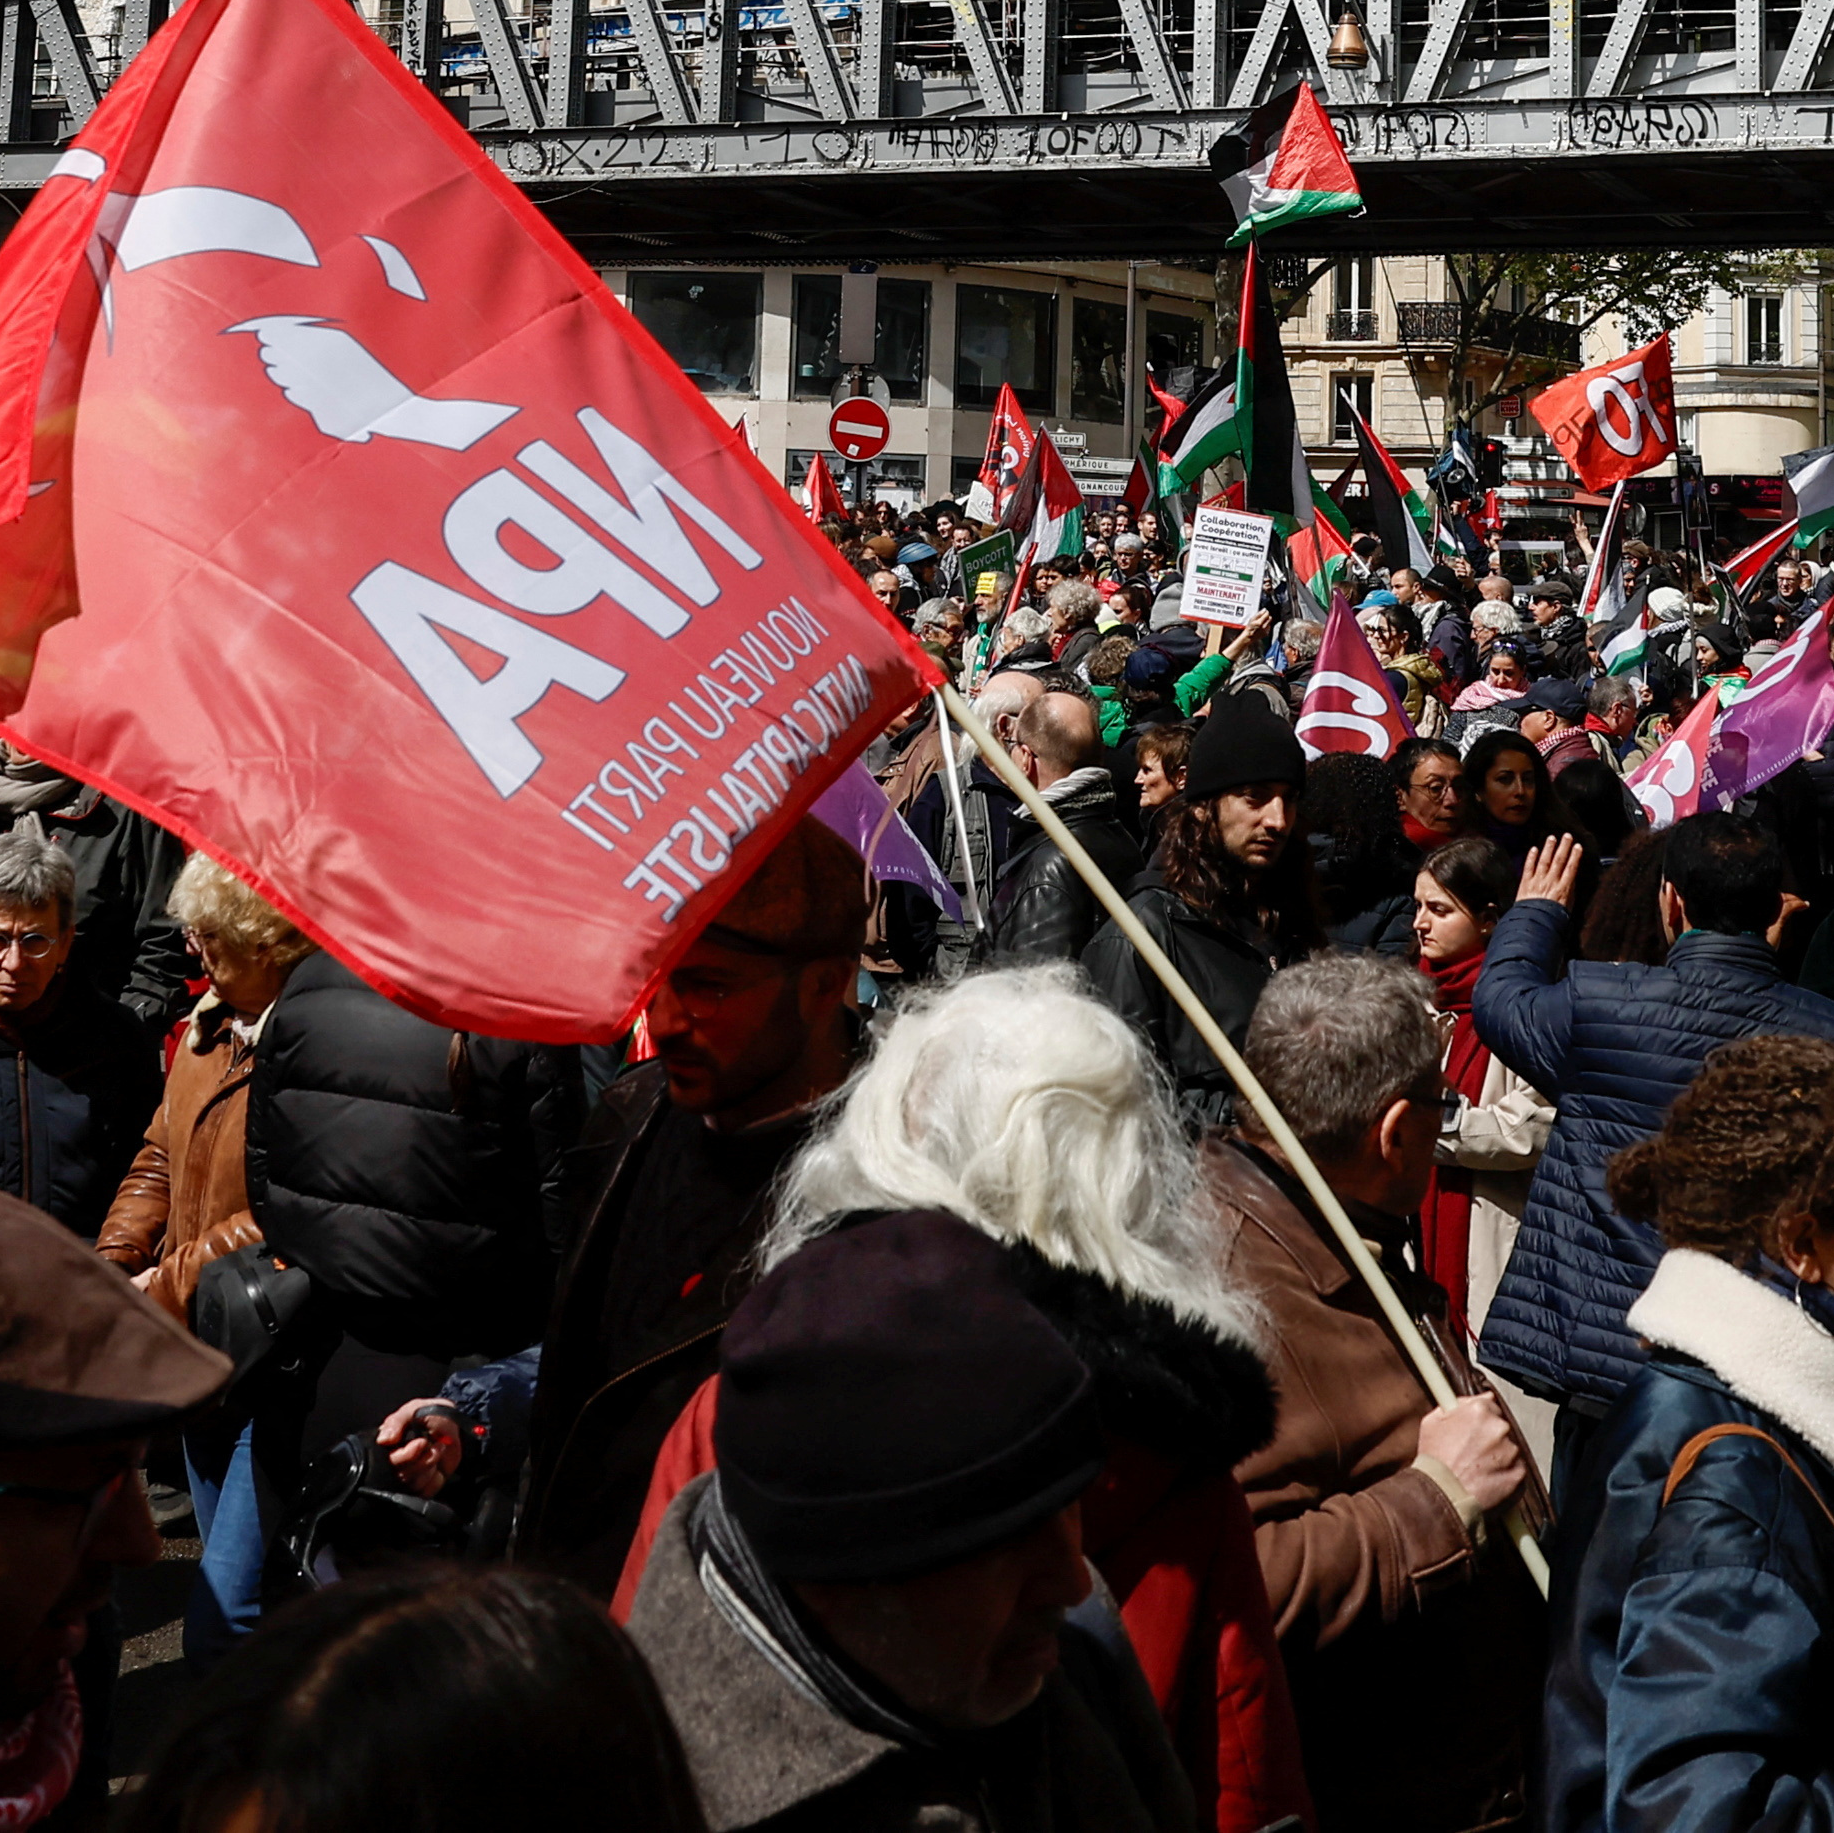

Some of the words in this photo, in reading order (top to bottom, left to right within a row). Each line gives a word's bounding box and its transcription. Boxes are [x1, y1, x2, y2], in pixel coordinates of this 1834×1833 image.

[1064, 458, 1109, 469] PHÉRIQUE
[1077, 482, 1126, 492] IGNANCOUR
[1200, 514, 1265, 534] Collaboration,
[1201, 523, 1261, 542] Coopération,
[965, 546, 1007, 574] BOYCOTT
[1197, 586, 1242, 601] MAINTENANT
